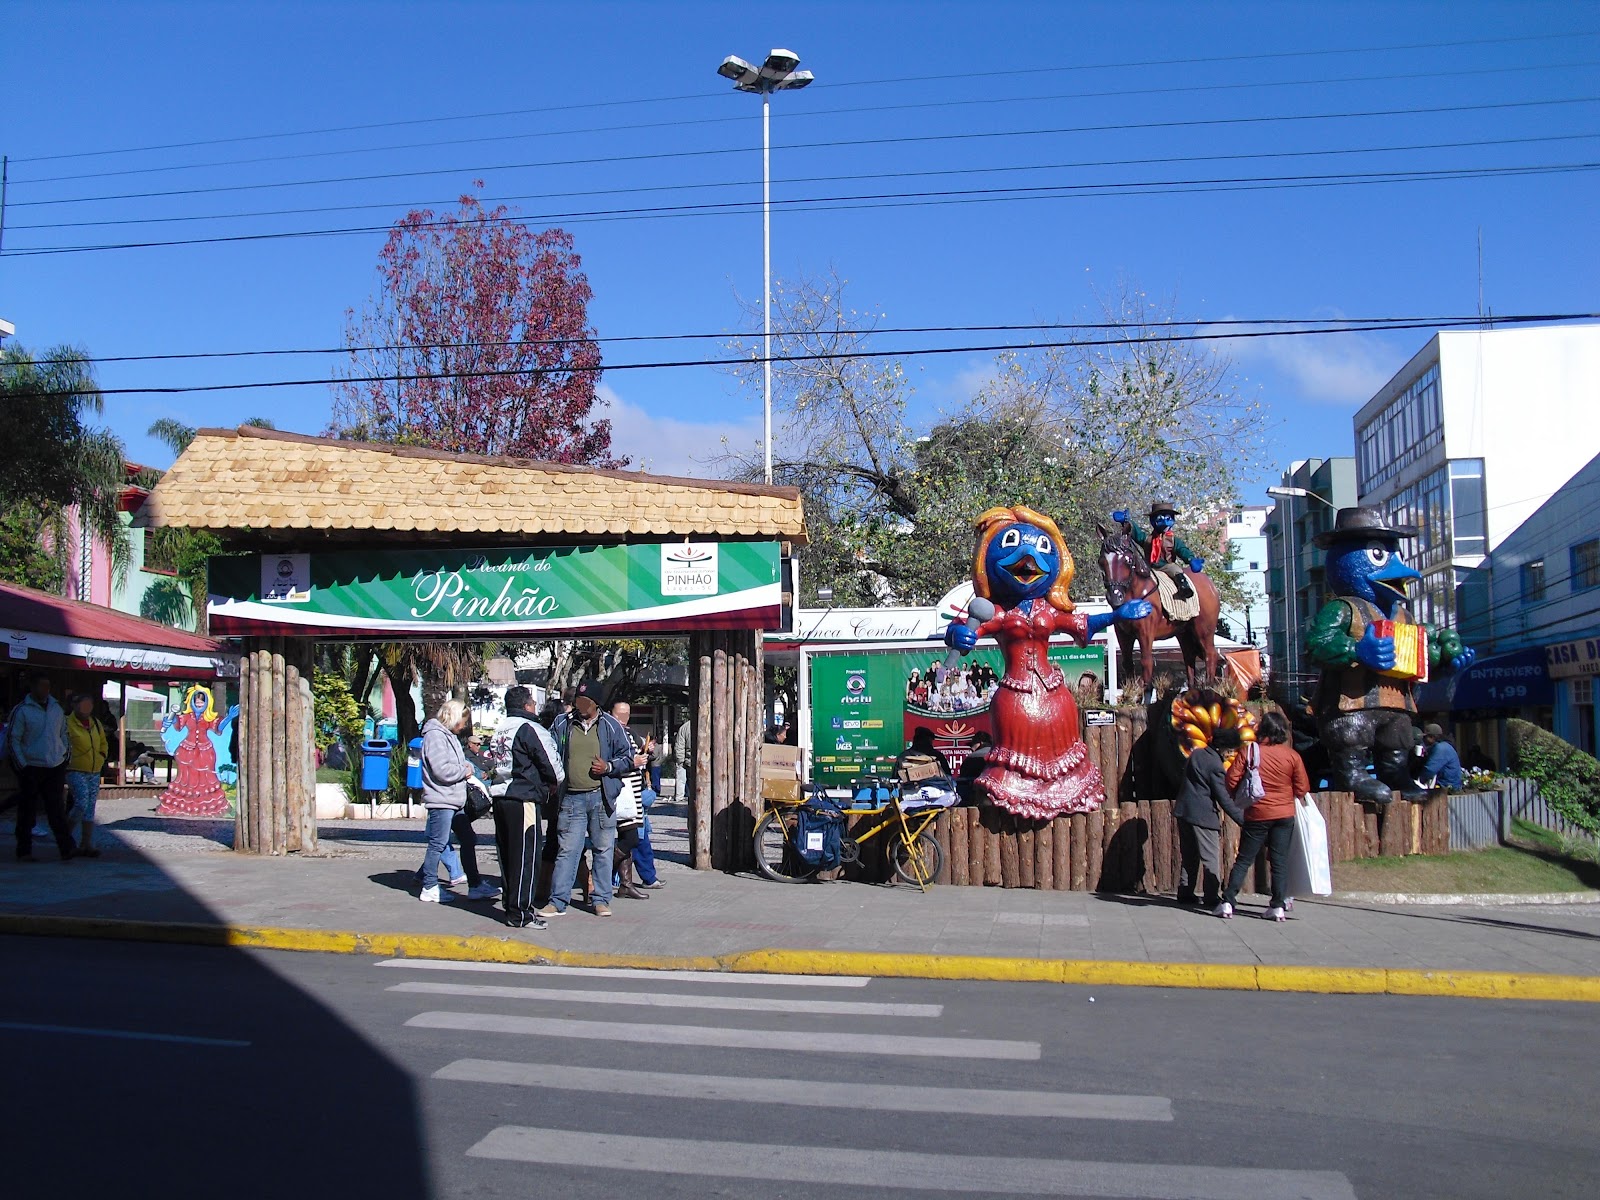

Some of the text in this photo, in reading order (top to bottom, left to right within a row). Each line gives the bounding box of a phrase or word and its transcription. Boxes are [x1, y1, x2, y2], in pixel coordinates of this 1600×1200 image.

[466, 554, 552, 573] Recanto do
[667, 573, 712, 585] PINHÃO
[410, 569, 560, 618] Pinhão
[850, 616, 921, 640] Central
[1470, 665, 1542, 680] ENTREVERO
[1487, 685, 1527, 699] 1,99
[835, 742, 853, 751] LAGES
